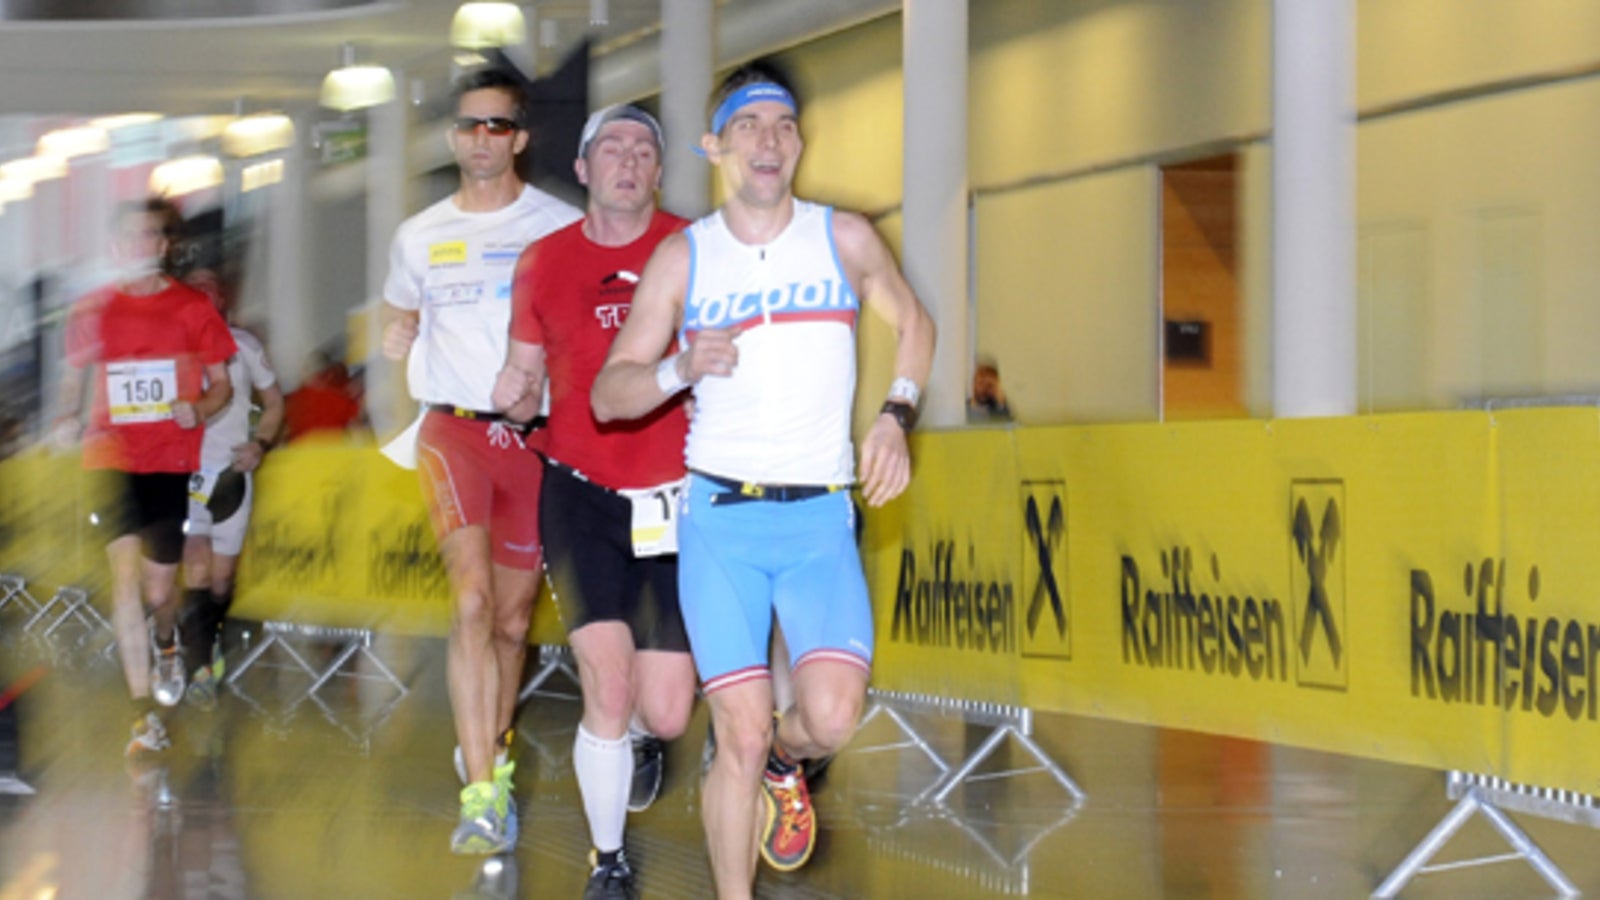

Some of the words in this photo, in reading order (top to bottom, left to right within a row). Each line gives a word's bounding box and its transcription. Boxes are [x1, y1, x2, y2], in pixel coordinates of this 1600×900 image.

[121, 377, 164, 403] 150
[890, 540, 1015, 654] Raiffeisen
[1121, 545, 1288, 683] Raiffeisen
